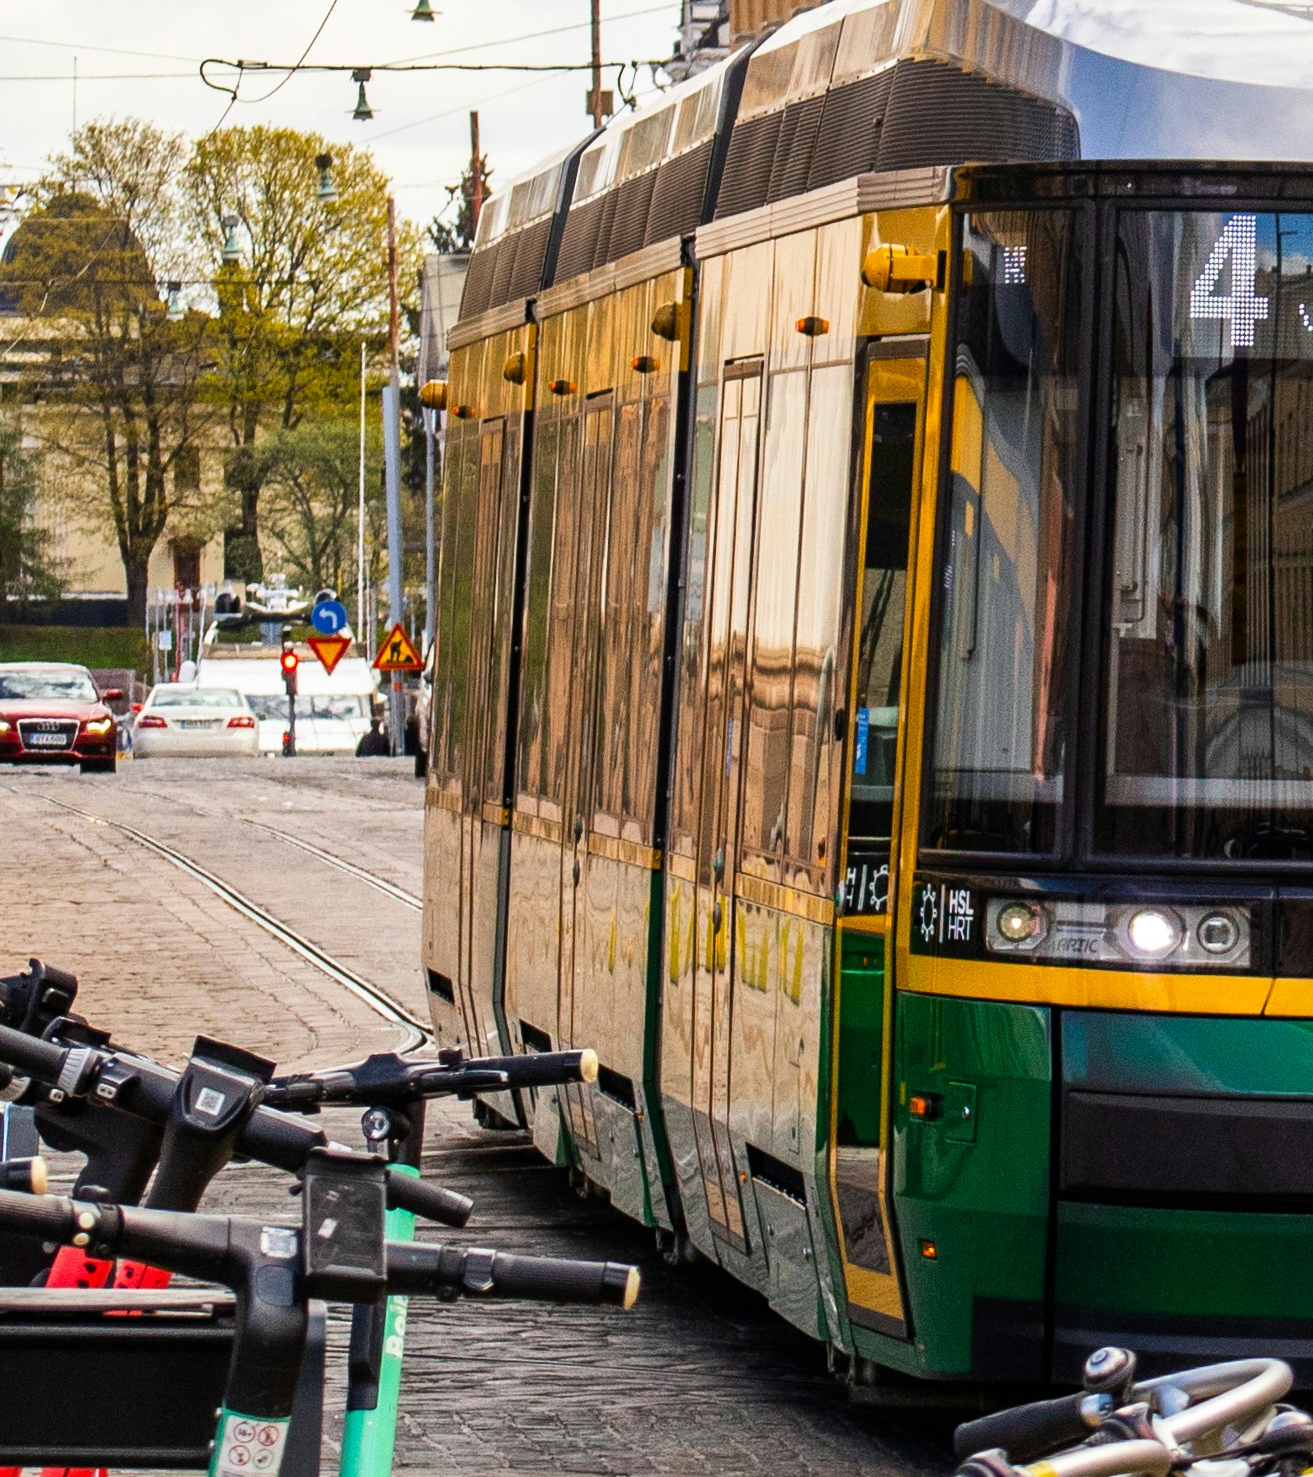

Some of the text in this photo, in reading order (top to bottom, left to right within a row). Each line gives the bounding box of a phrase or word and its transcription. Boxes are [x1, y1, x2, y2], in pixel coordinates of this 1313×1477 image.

[1189, 215, 1269, 346] 4
[949, 890, 974, 915] HSL
[948, 915, 974, 941] HRT
